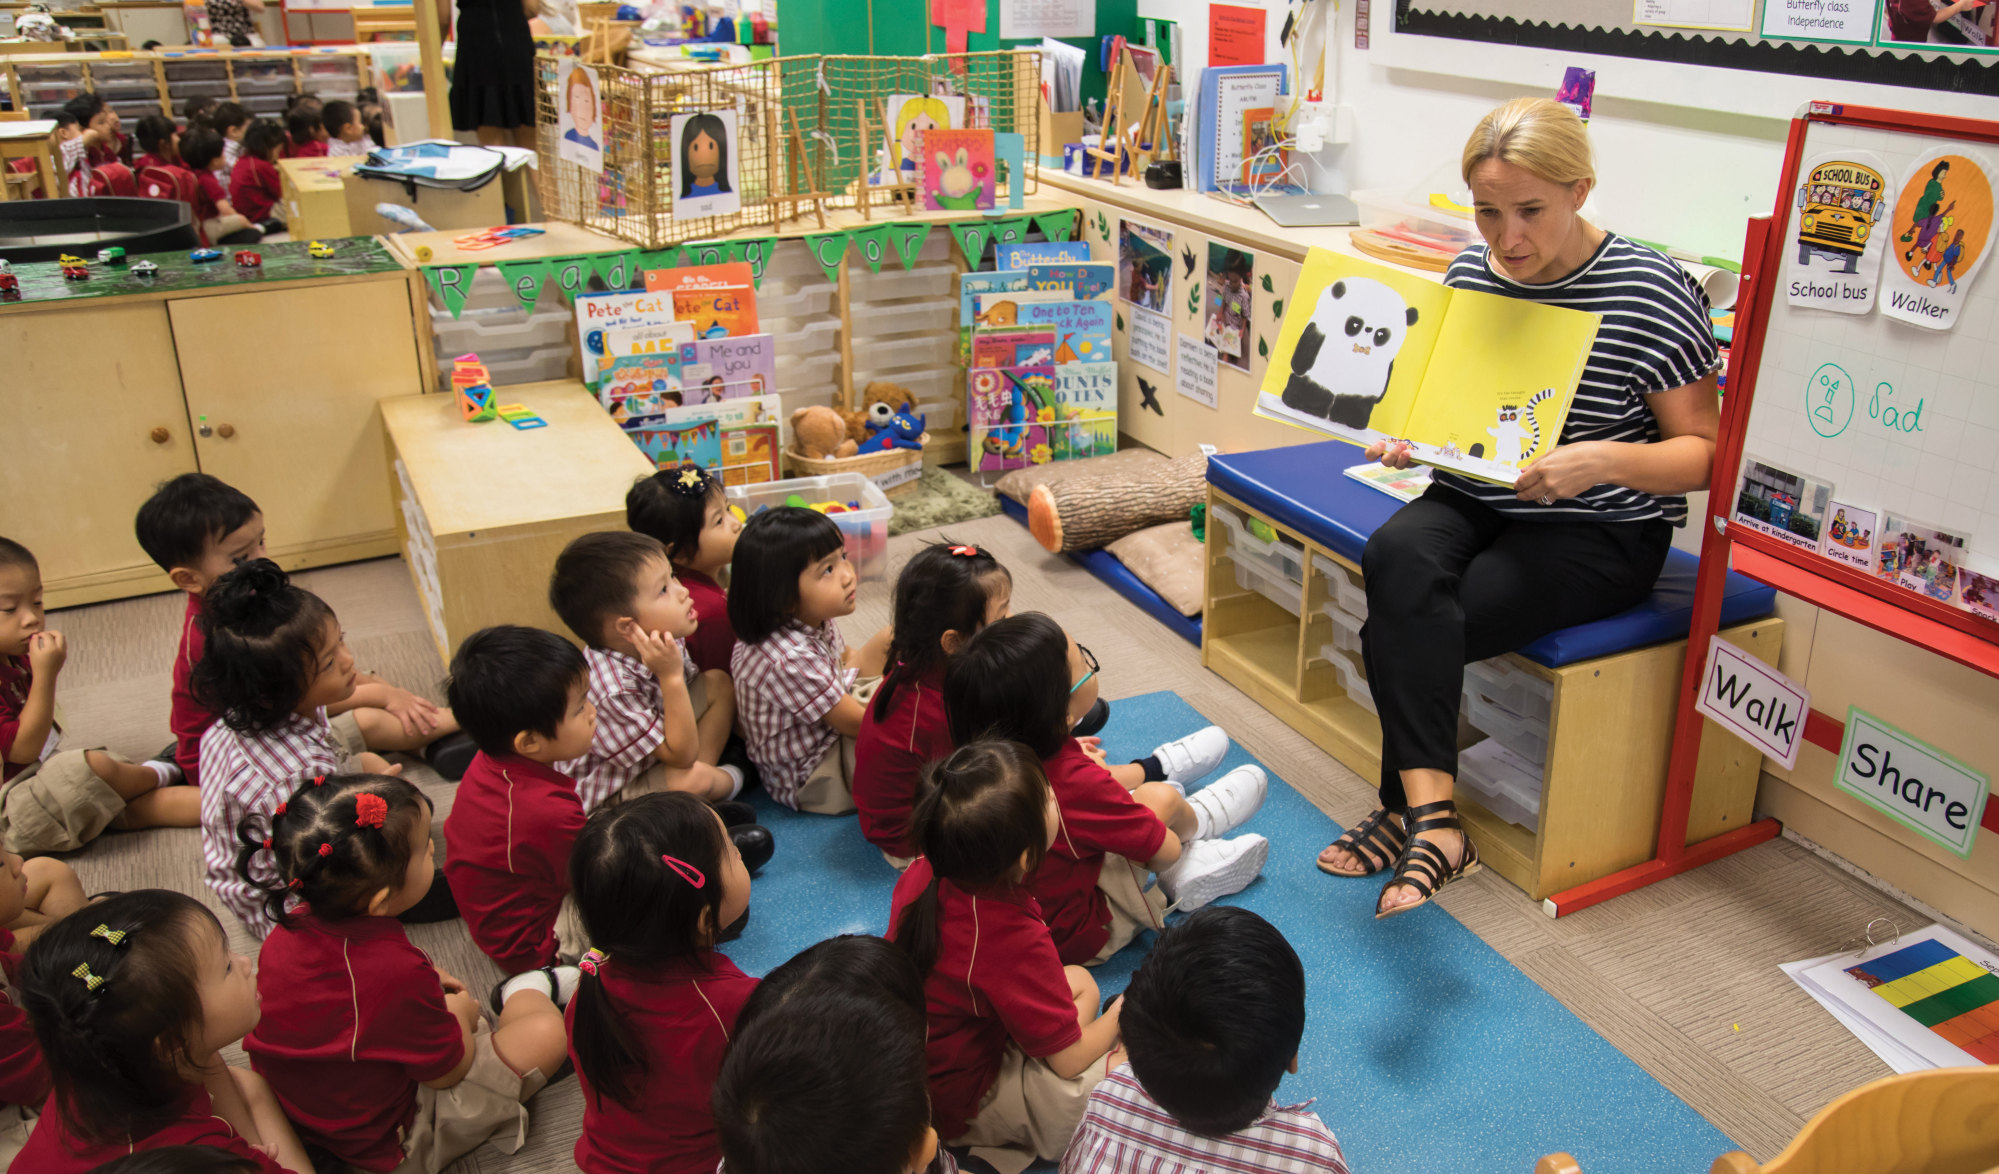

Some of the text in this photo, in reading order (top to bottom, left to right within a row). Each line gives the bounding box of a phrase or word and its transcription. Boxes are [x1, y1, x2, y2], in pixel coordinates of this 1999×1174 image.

[1786, 0, 1825, 16] Butterfly
[1788, 15, 1844, 30] Independence
[1823, 169, 1871, 187] SCHOOL BUS
[1010, 251, 1075, 269] Butterfly
[1049, 269, 1095, 278] How Do
[964, 281, 994, 295] Duck
[1036, 281, 1074, 291] YOU
[1789, 281, 1867, 300] School bus
[587, 302, 622, 319] Pete
[635, 298, 664, 313] Cat
[713, 297, 741, 312] Cat
[1032, 304, 1095, 318] One to Ten
[1891, 290, 1949, 319] Walker
[1075, 316, 1104, 330] Again
[632, 329, 667, 341] all about
[631, 338, 673, 355] ME
[710, 342, 761, 360] Me and
[724, 359, 751, 376] you
[1056, 376, 1112, 390] OUNTS
[1073, 389, 1104, 402] TEN
[1869, 381, 1924, 433] Sad
[881, 472, 902, 487] with
[1739, 516, 1759, 529] Arrive
[1772, 527, 1816, 551] kindergarten
[1827, 548, 1869, 567] Circle time
[1900, 578, 1918, 591] Play
[1971, 607, 1999, 624] Snack
[1716, 664, 1796, 745] Walk
[1850, 743, 1969, 831] Share
